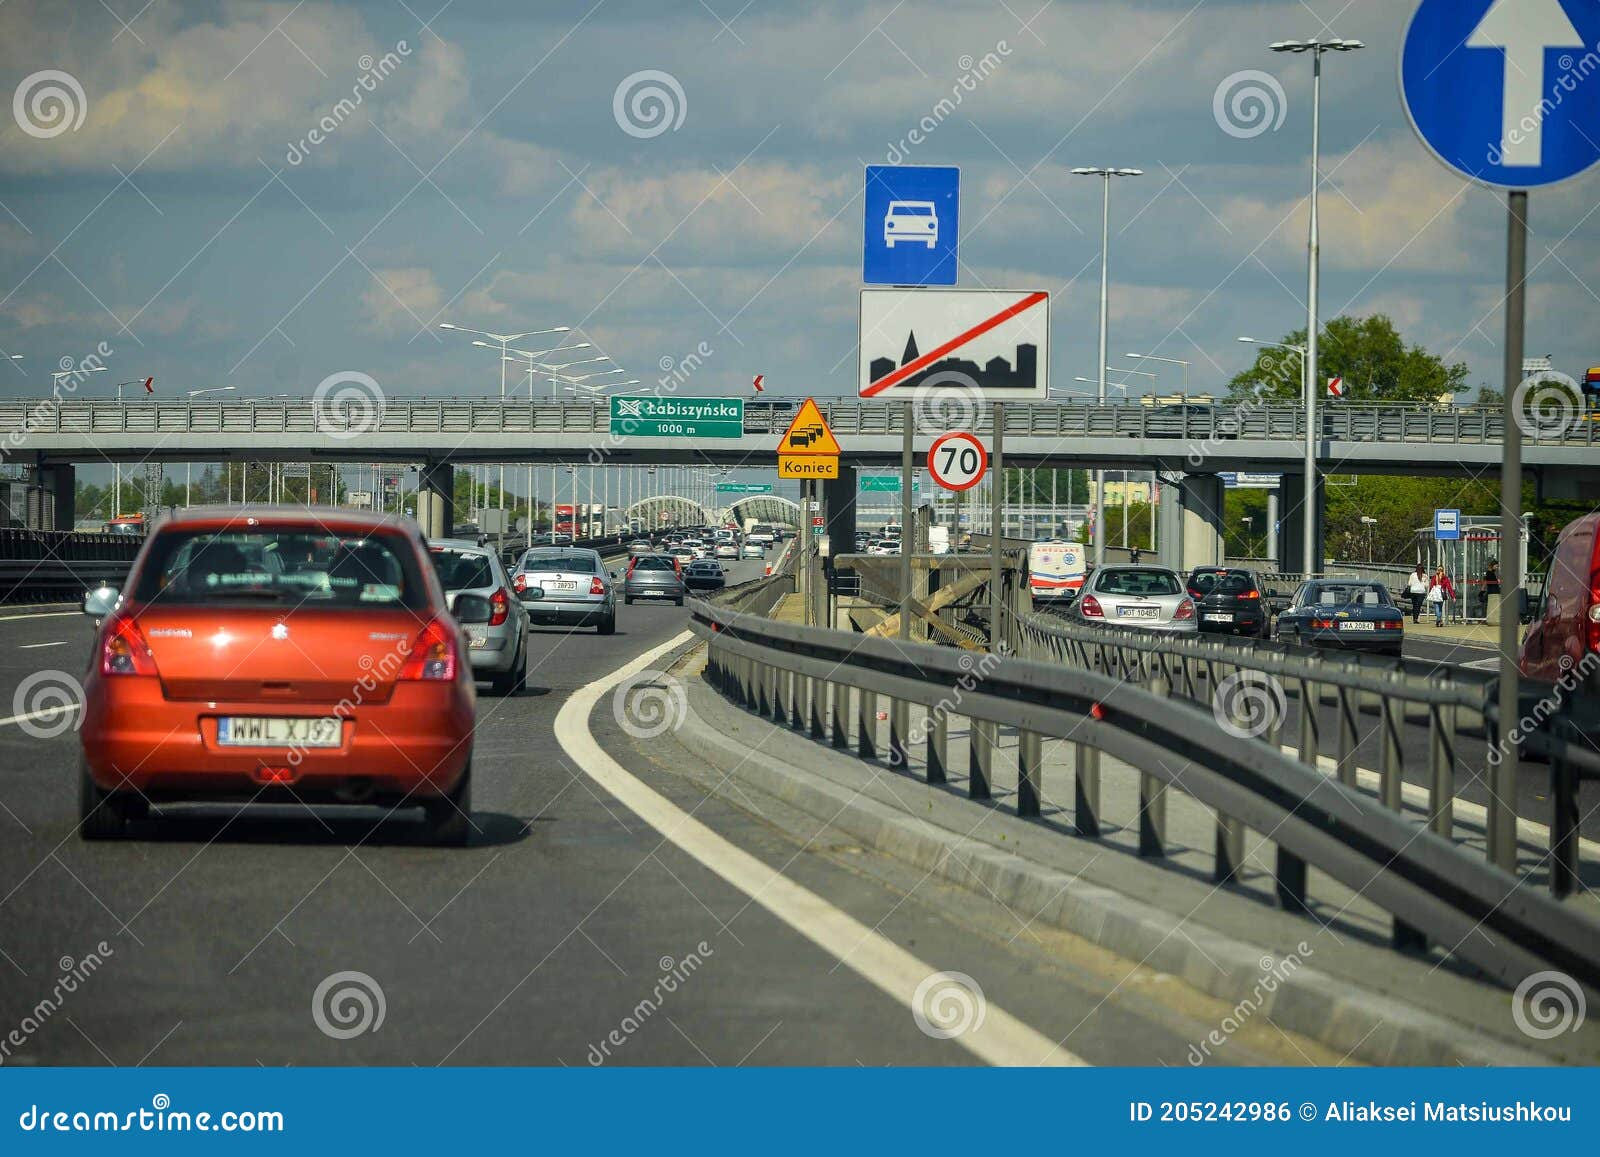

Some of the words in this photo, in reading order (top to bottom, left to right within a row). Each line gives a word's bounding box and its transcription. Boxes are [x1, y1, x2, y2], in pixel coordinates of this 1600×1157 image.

[647, 401, 738, 420] Łabiszyńska
[657, 424, 683, 434] 1000
[686, 426, 696, 434] m
[784, 461, 833, 473] Koniec
[940, 447, 978, 475] 70
[233, 717, 277, 740] WWL
